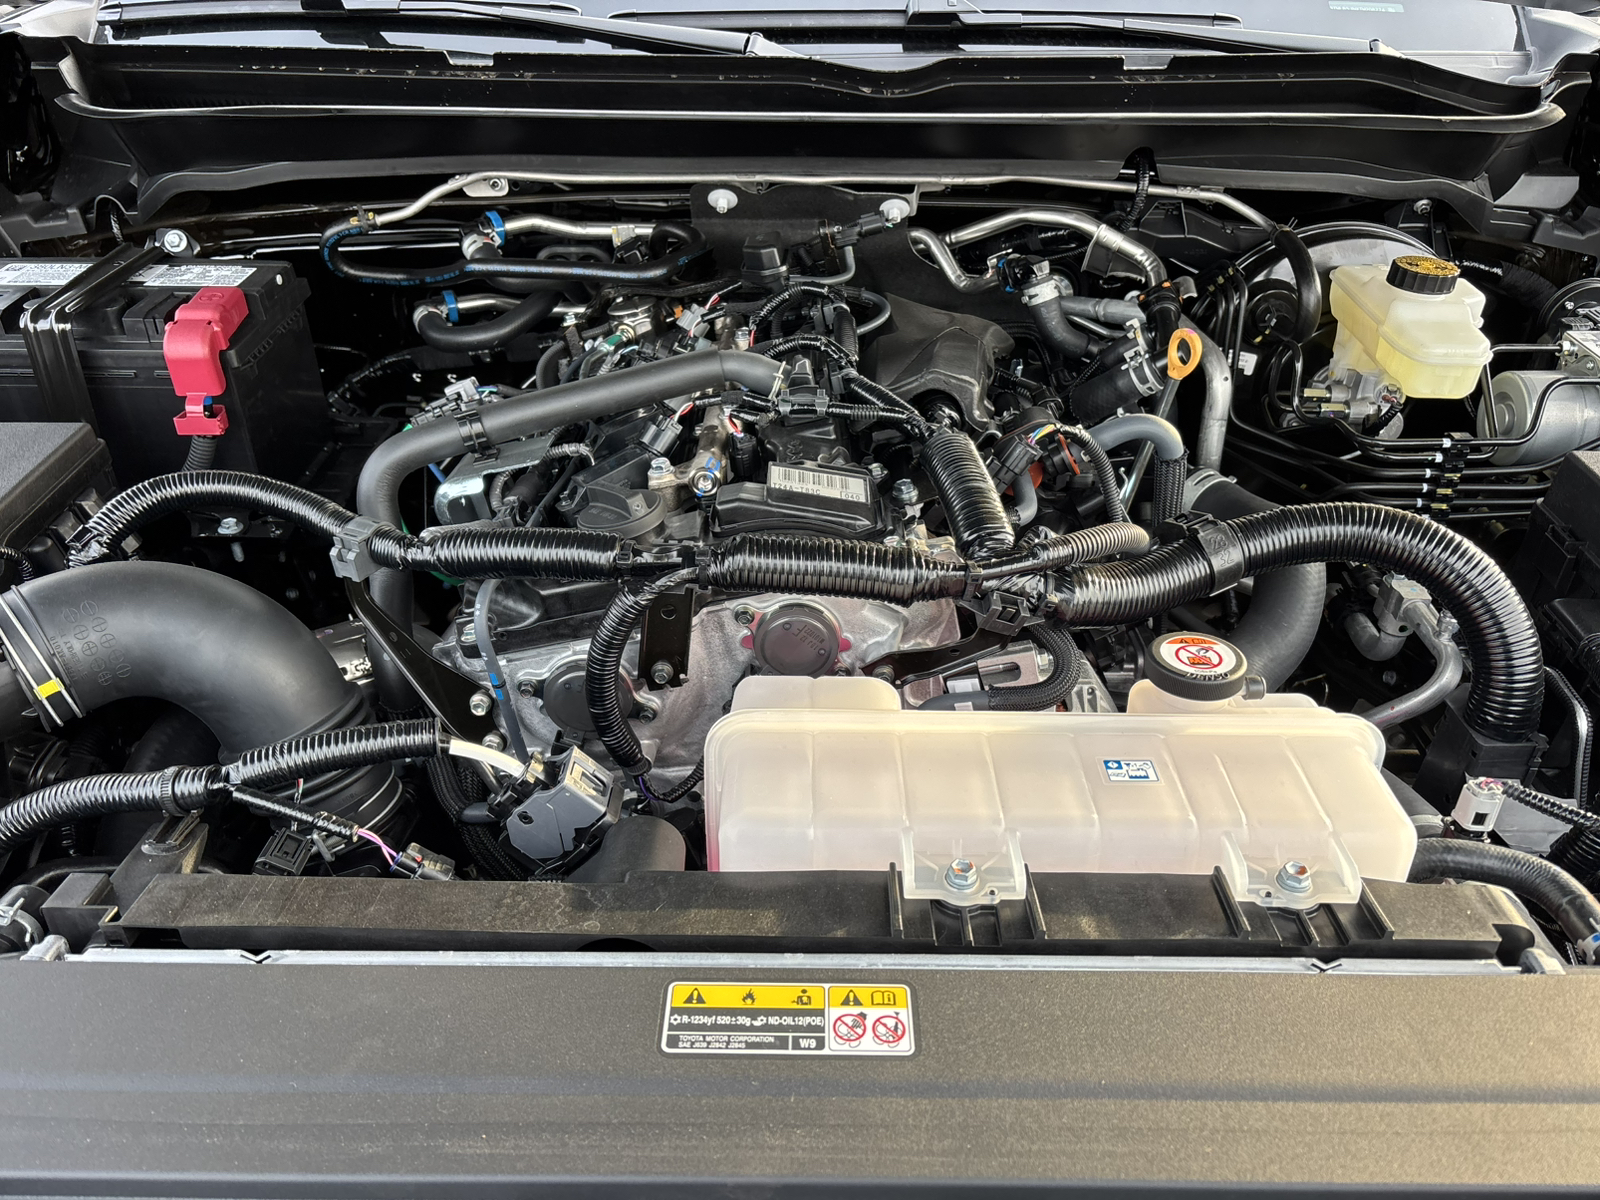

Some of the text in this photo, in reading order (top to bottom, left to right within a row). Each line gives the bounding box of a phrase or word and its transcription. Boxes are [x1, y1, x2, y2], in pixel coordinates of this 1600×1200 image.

[844, 493, 861, 501] 040
[1209, 534, 1228, 550] 28
[1219, 549, 1235, 568] 32
[1187, 671, 1230, 681] DENSO
[681, 1015, 825, 1027] R-1234yf 520±30g ND-OIL12(POE)
[705, 1035, 728, 1043] MOTOR
[799, 1038, 817, 1048] W9
[678, 1041, 691, 1049] SAE
